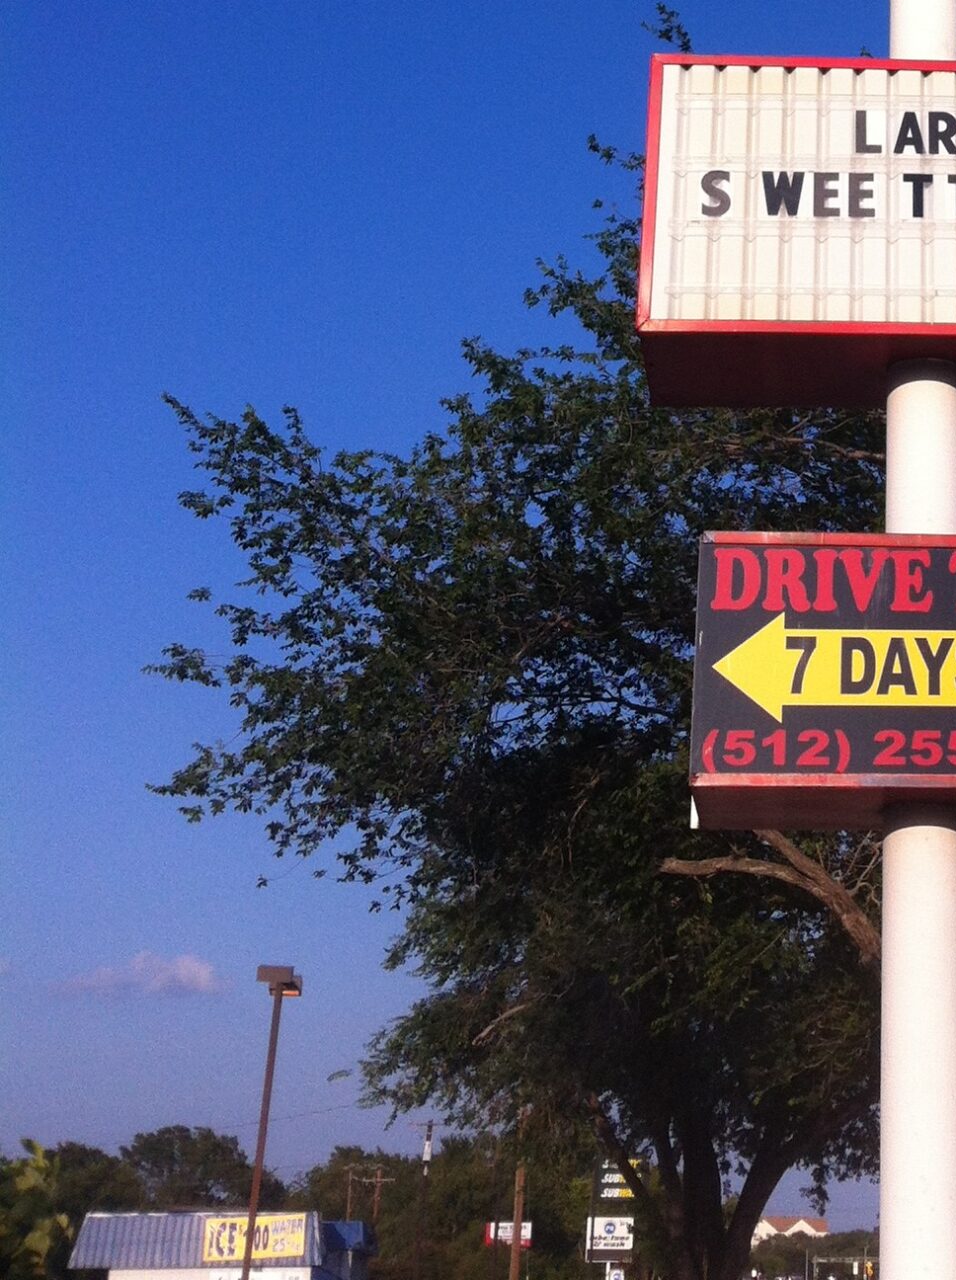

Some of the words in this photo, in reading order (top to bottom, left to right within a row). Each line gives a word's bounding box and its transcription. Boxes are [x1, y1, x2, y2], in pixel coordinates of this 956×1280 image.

[709, 547, 934, 614] DRIVE
[785, 636, 817, 695] 7
[701, 729, 851, 774] (512)
